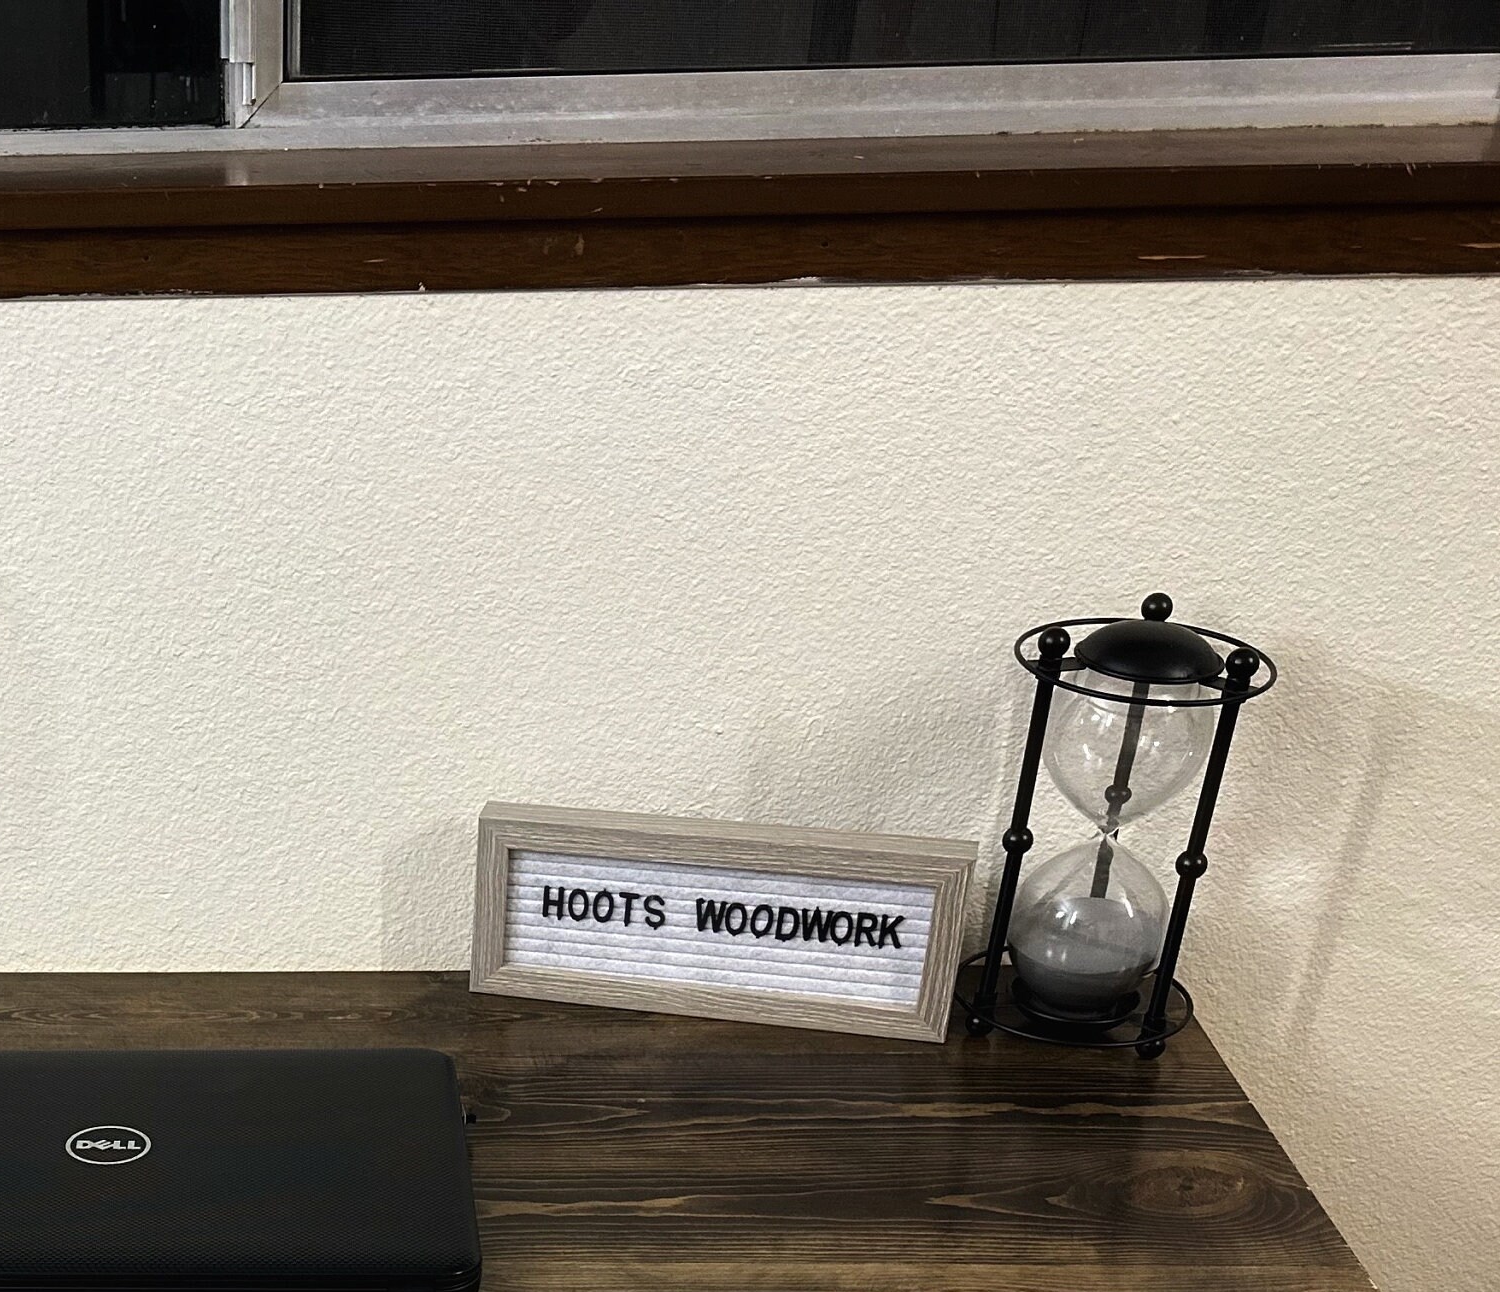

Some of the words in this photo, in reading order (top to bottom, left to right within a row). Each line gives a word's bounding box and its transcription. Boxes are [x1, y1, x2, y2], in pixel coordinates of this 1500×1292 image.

[542, 885, 665, 930] HOOTS
[696, 898, 904, 949] WOODWORK
[75, 1139, 141, 1150] DELL
